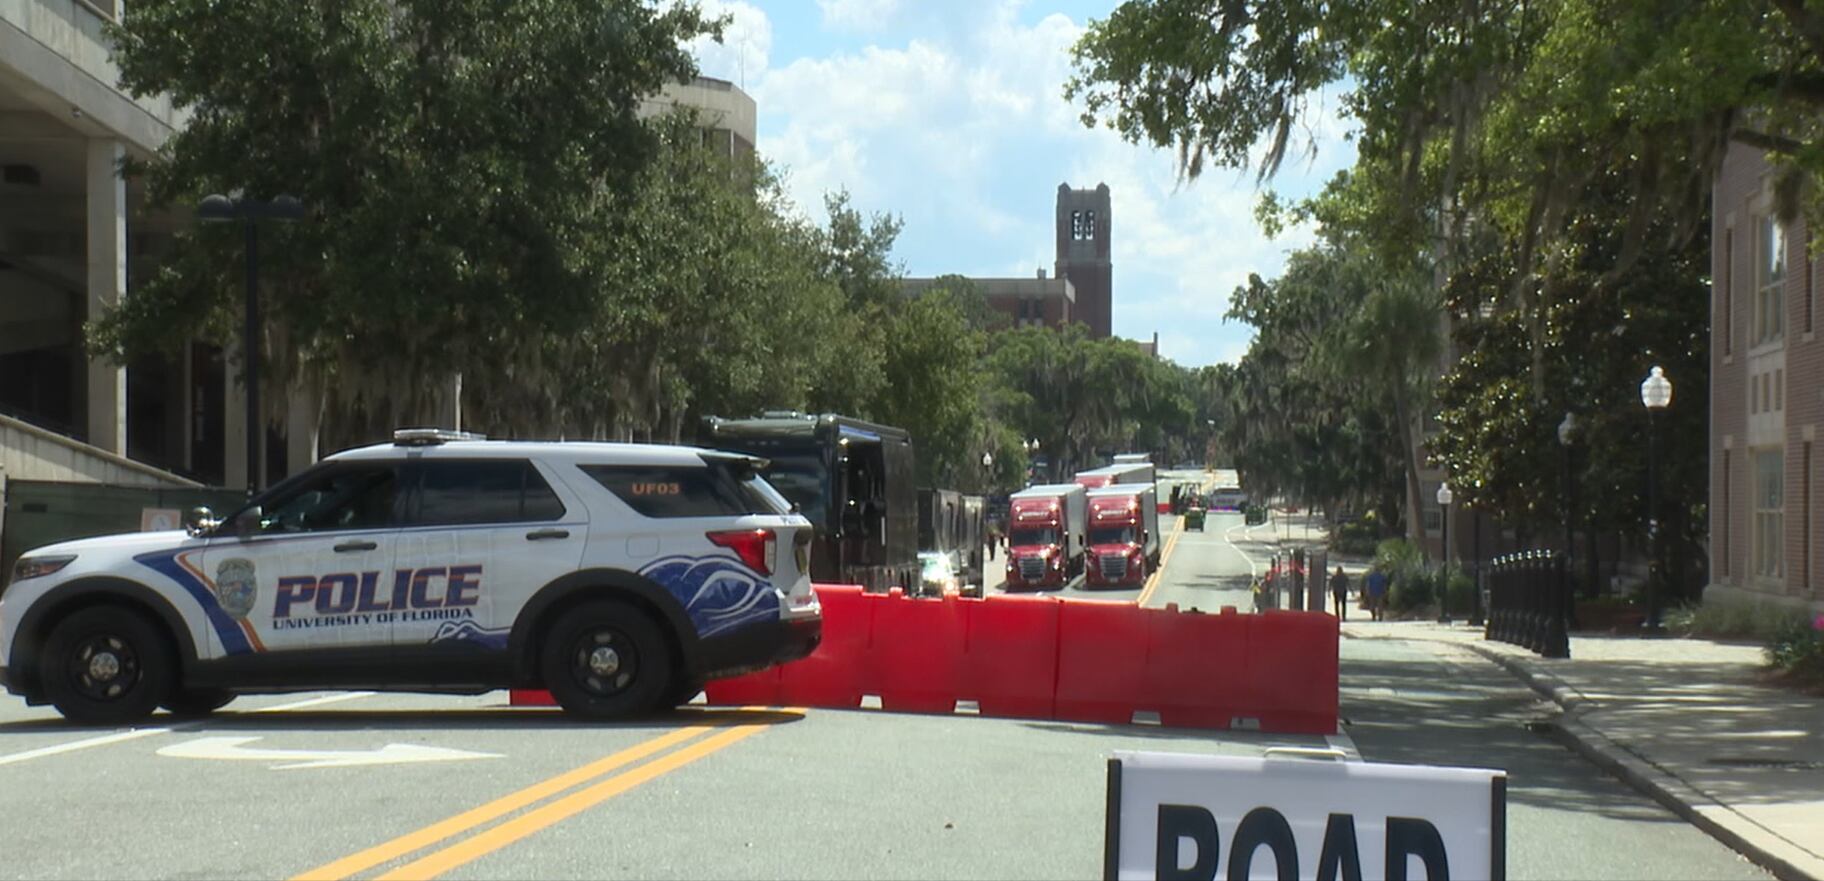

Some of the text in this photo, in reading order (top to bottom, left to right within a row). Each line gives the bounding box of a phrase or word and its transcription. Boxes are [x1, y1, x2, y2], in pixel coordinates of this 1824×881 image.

[632, 482, 680, 495] UF03
[273, 565, 482, 618] POLICE
[272, 608, 473, 630] UNIVERSITY OF FLORIDA
[1155, 803, 1450, 881] ROAD
